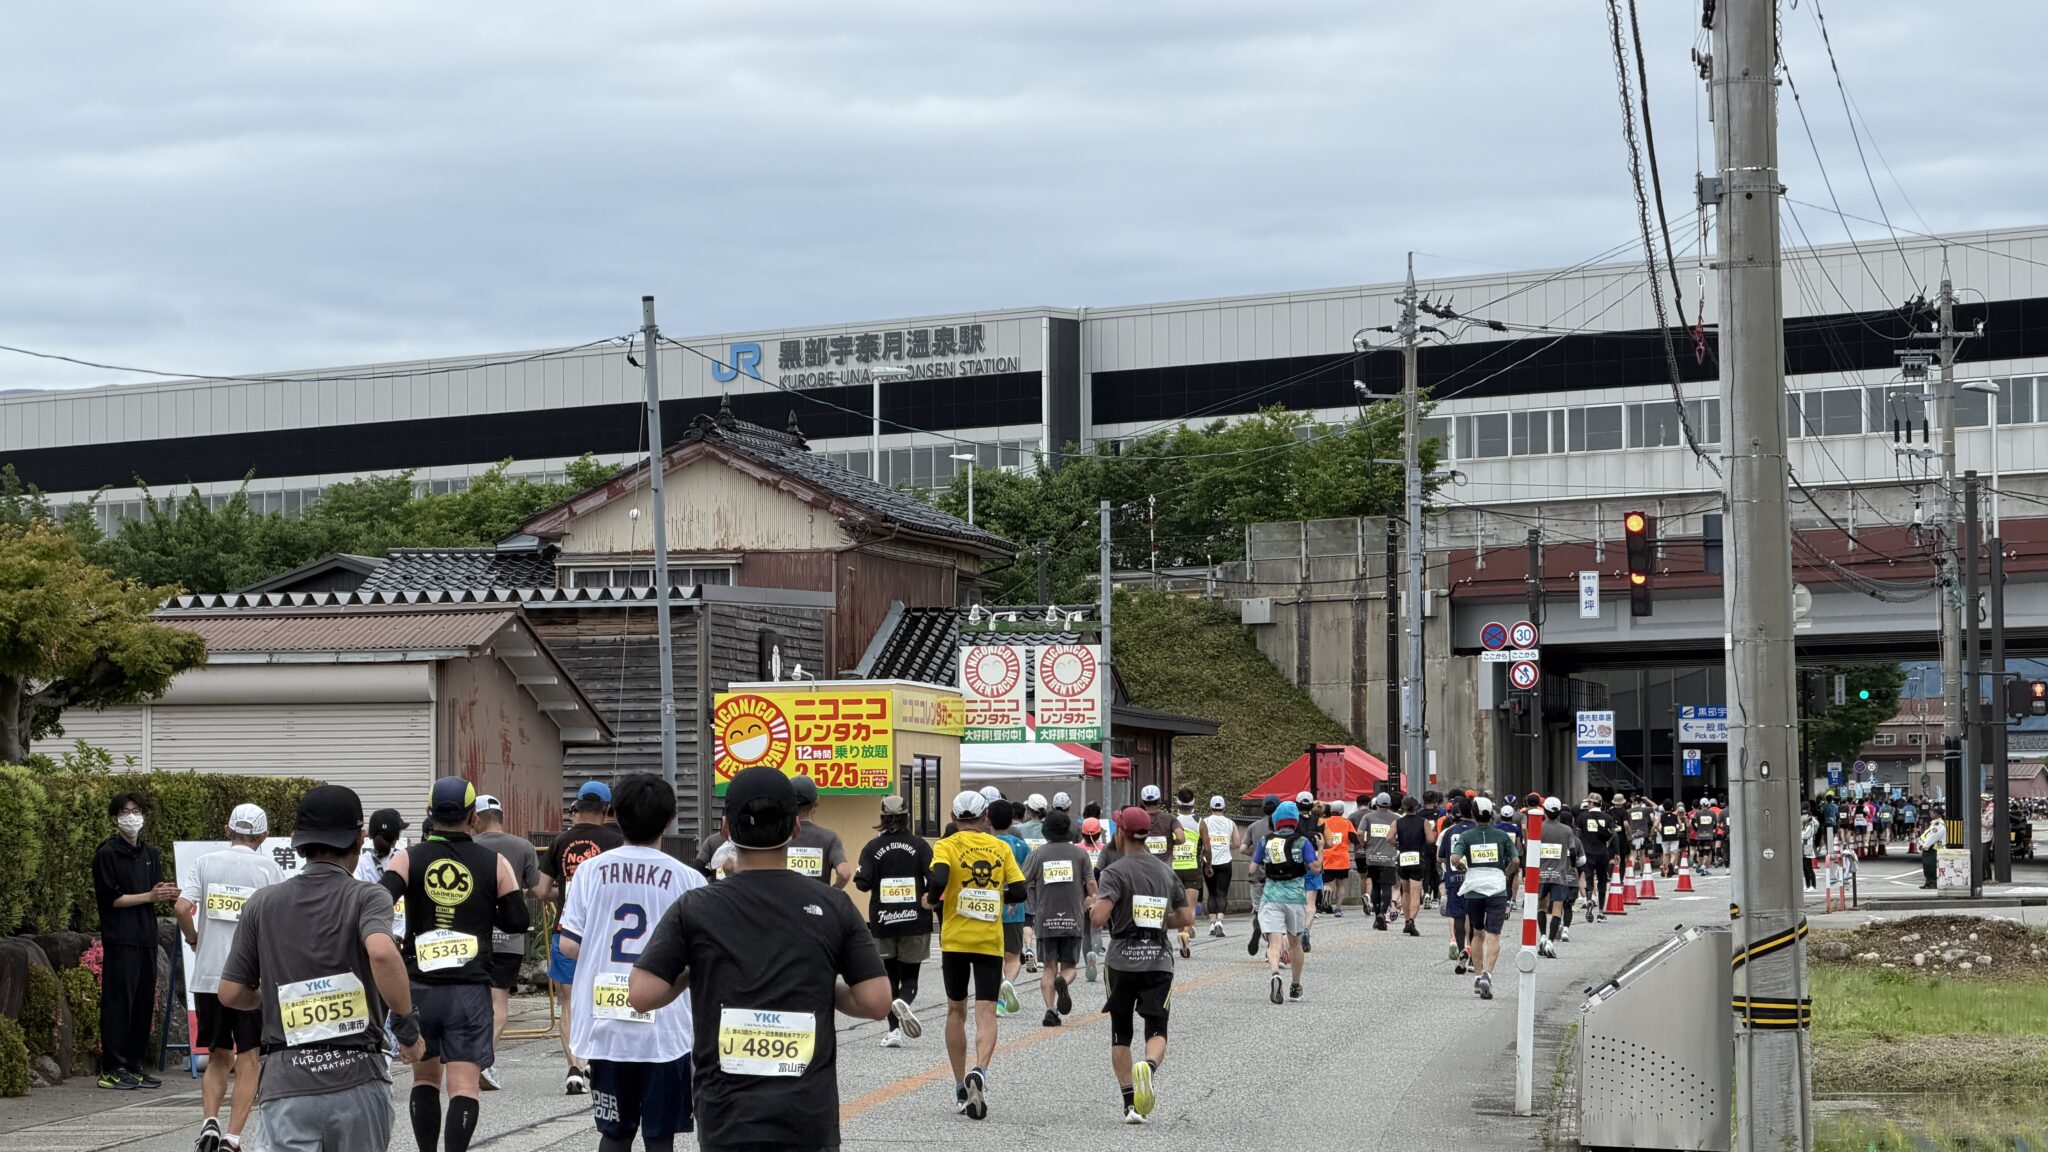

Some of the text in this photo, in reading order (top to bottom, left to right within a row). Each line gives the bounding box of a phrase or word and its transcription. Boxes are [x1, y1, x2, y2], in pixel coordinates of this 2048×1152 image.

[779, 324, 985, 369] 黒部宇奈月温泉駅
[712, 342, 761, 382] JR
[959, 357, 1020, 376] STATION
[1584, 586, 1595, 611] 寺坪
[1516, 629, 1531, 641] 30
[968, 645, 1012, 668] NICONICO
[973, 670, 1018, 697] RENTACAR
[1048, 670, 1094, 696] RENTACAR
[794, 698, 887, 721] ニコニコ
[964, 699, 1020, 713] ニコニコ
[1041, 698, 1095, 712] ニコニコ
[965, 713, 1021, 725] レンタカー
[1041, 713, 1097, 725] レンタカー
[794, 723, 889, 742] レンタカー
[1578, 724, 1588, 738] P
[796, 744, 889, 760] 12時間 乗り放題
[860, 776, 871, 787] 円
[790, 859, 816, 869] 5010
[599, 862, 672, 891] TANAKA
[225, 885, 241, 893] YKK
[889, 888, 911, 896] 6619
[207, 899, 214, 909] G
[968, 902, 995, 912] 4638
[1134, 909, 1163, 920] H 434
[611, 903, 647, 963] 2
[419, 950, 427, 962] K
[432, 943, 468, 959] 5343
[305, 979, 332, 991] YKK
[595, 992, 602, 1006] J
[287, 1000, 354, 1028] J 5055
[753, 1012, 781, 1024] YKK
[338, 1019, 365, 1033] 魚津市
[723, 1037, 799, 1058] J 4896
[291, 1050, 341, 1067] KUROBE
[778, 1062, 807, 1073] 富山市
[592, 1089, 618, 1111] DER
[595, 1105, 621, 1123] OUR
